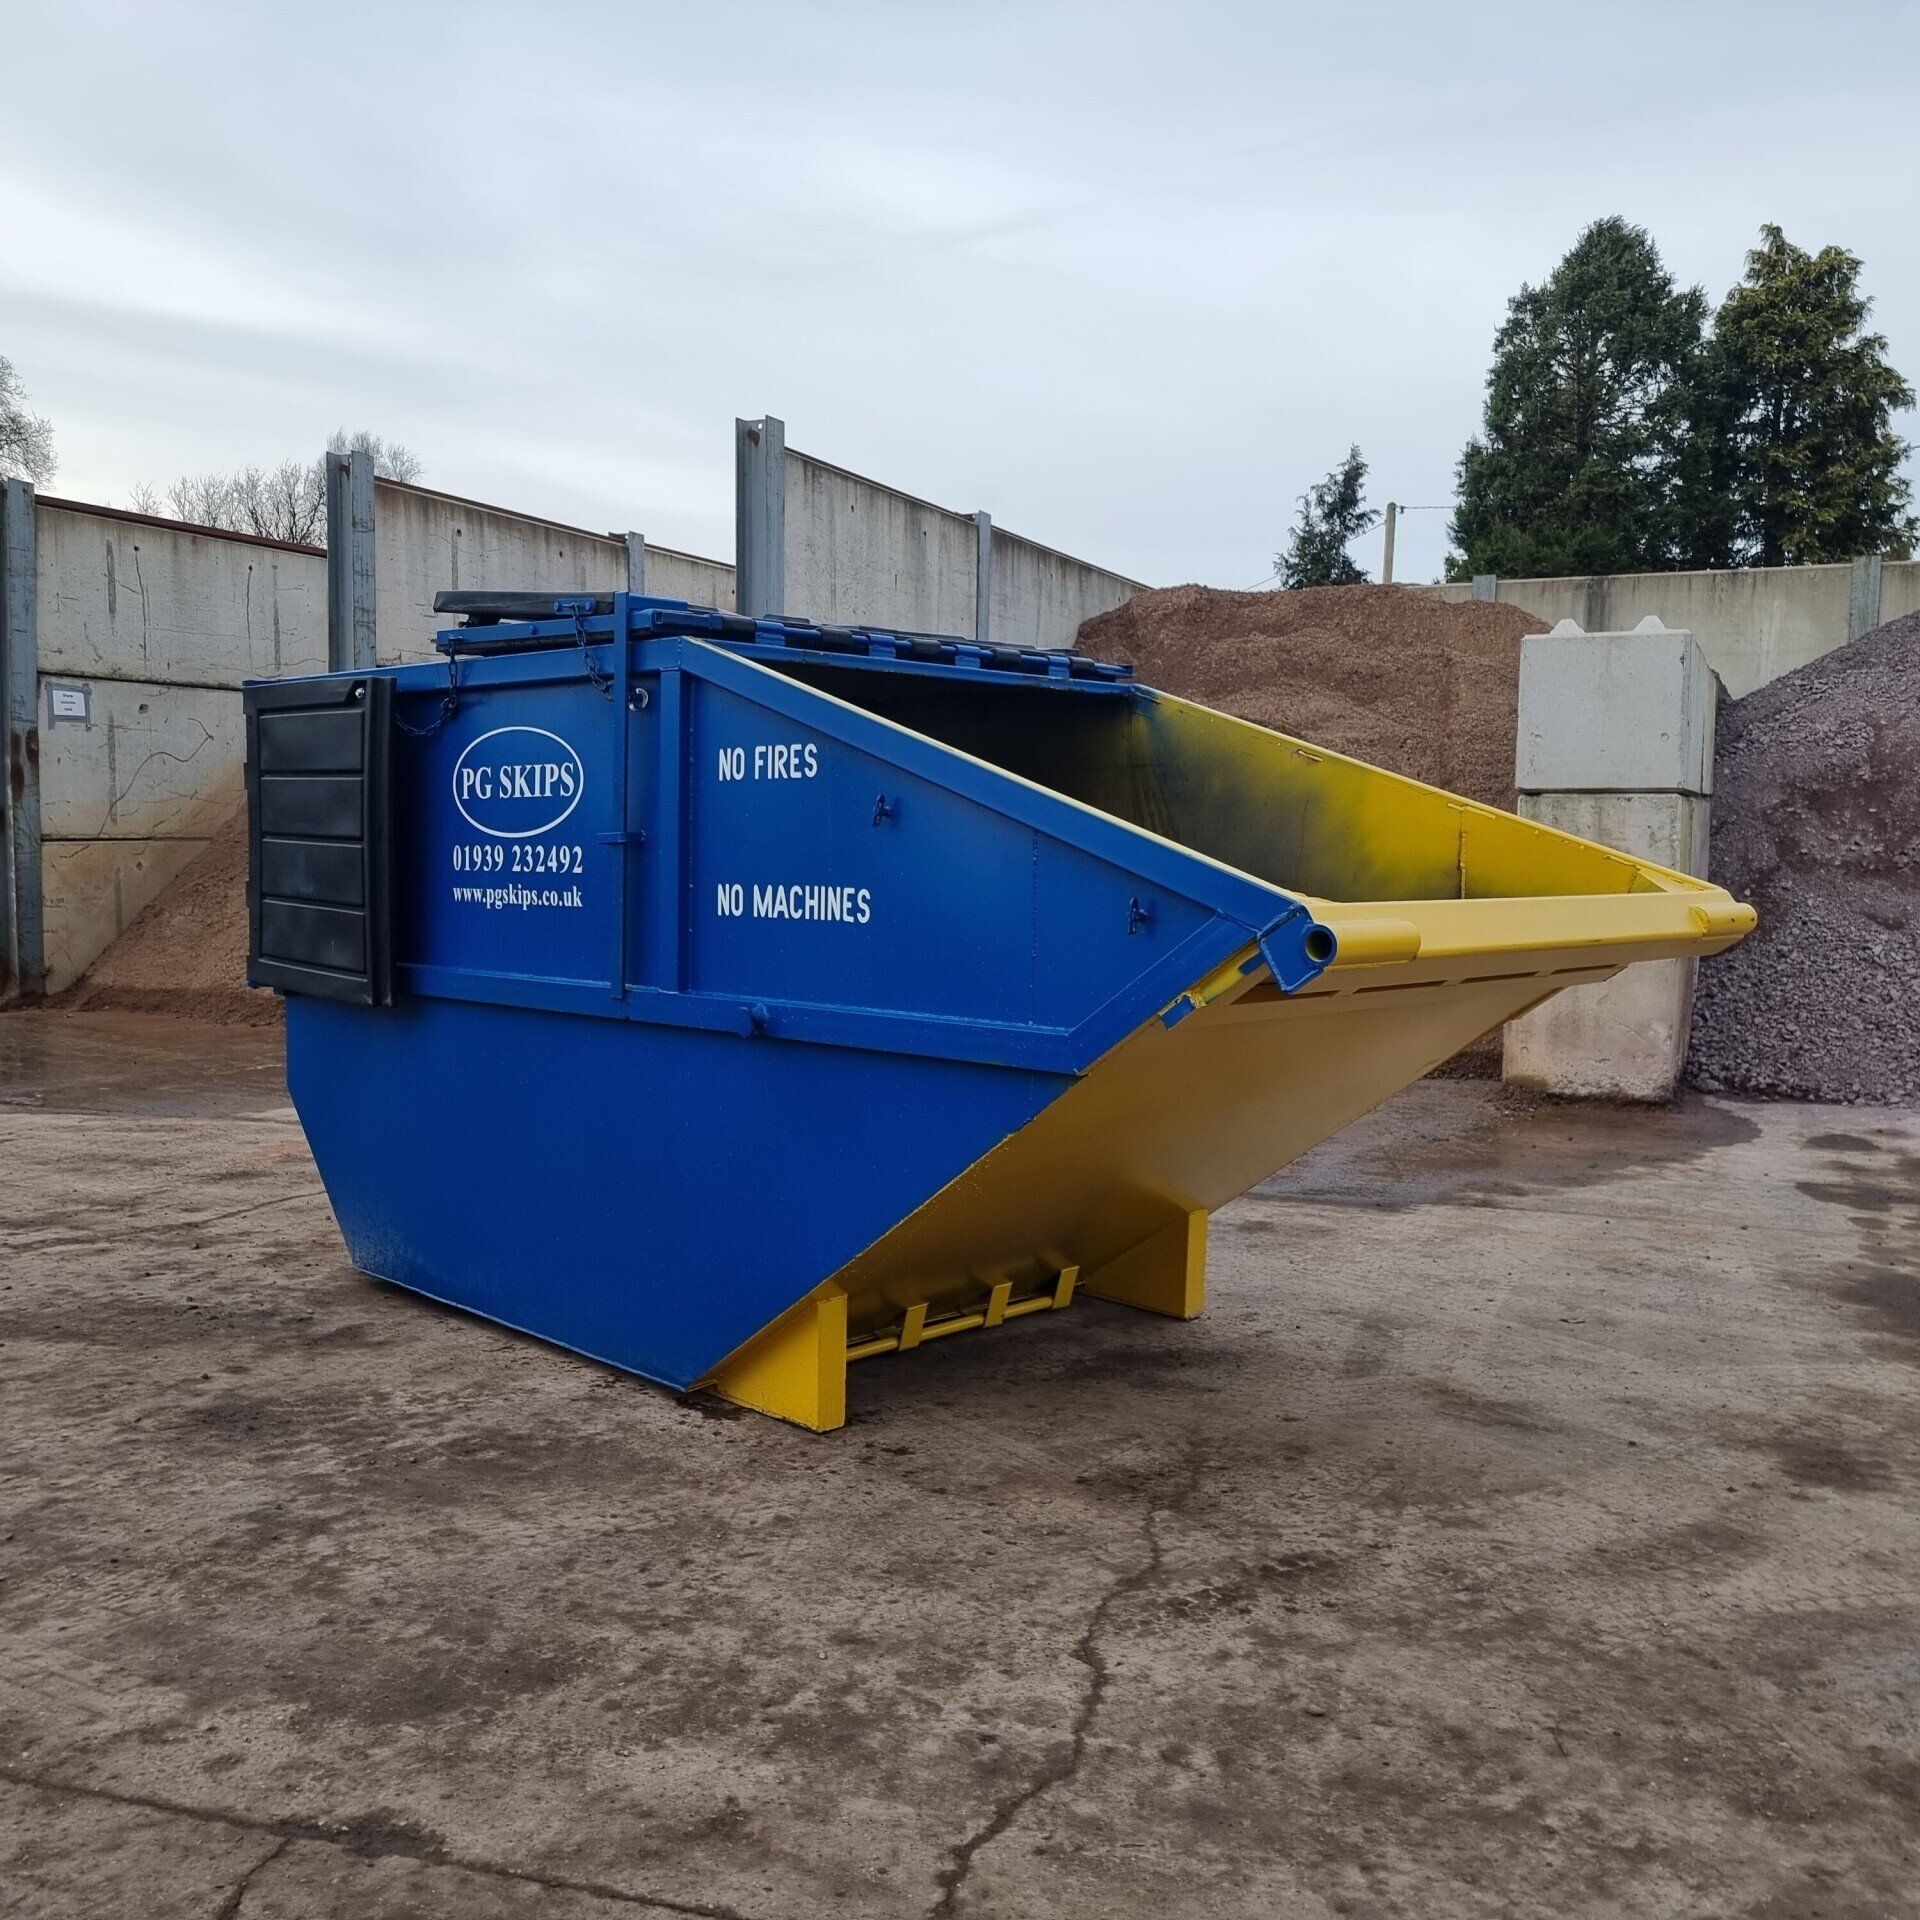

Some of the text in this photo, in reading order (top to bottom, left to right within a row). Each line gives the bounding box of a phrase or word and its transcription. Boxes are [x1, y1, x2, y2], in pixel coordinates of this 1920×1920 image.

[461, 762, 575, 800] PG SKIPS
[718, 743, 819, 782] NO FIRES
[452, 845, 583, 874] 01939 232492
[452, 883, 583, 911] www.pgskips.co.uk
[717, 883, 871, 924] NO MACHINES
